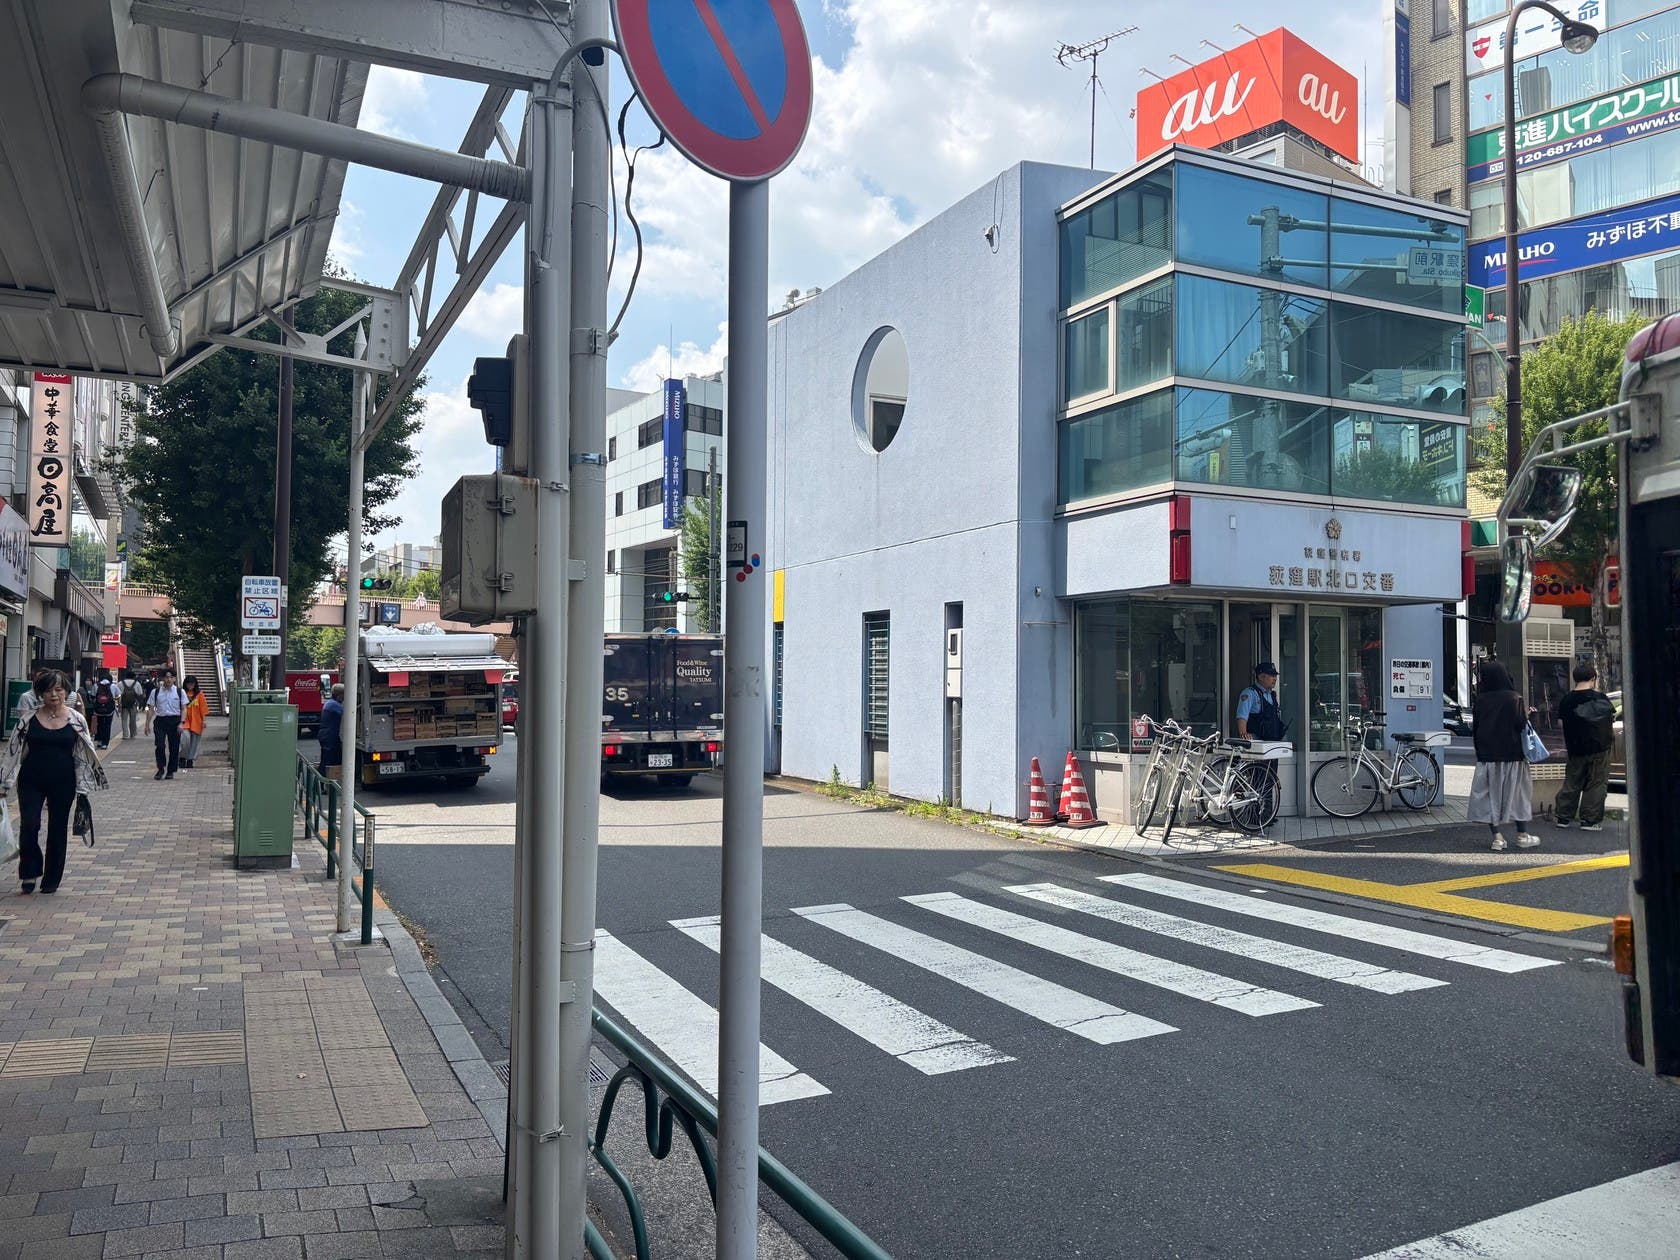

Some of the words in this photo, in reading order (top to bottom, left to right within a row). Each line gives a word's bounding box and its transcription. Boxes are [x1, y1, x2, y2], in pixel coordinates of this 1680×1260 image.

[1161, 71, 1256, 141] au
[1298, 73, 1347, 125] au
[1484, 241, 1555, 270] MIUHO
[43, 386, 60, 453] 中華食堂
[119, 405, 131, 438] ENTER
[31, 457, 63, 537] 日高屋
[244, 587, 279, 595] 禁止区域
[1269, 565, 1395, 592] 荻窪駅北口交番
[676, 666, 712, 677] Quality
[1392, 672, 1405, 680] 死亡
[605, 687, 629, 701] 35
